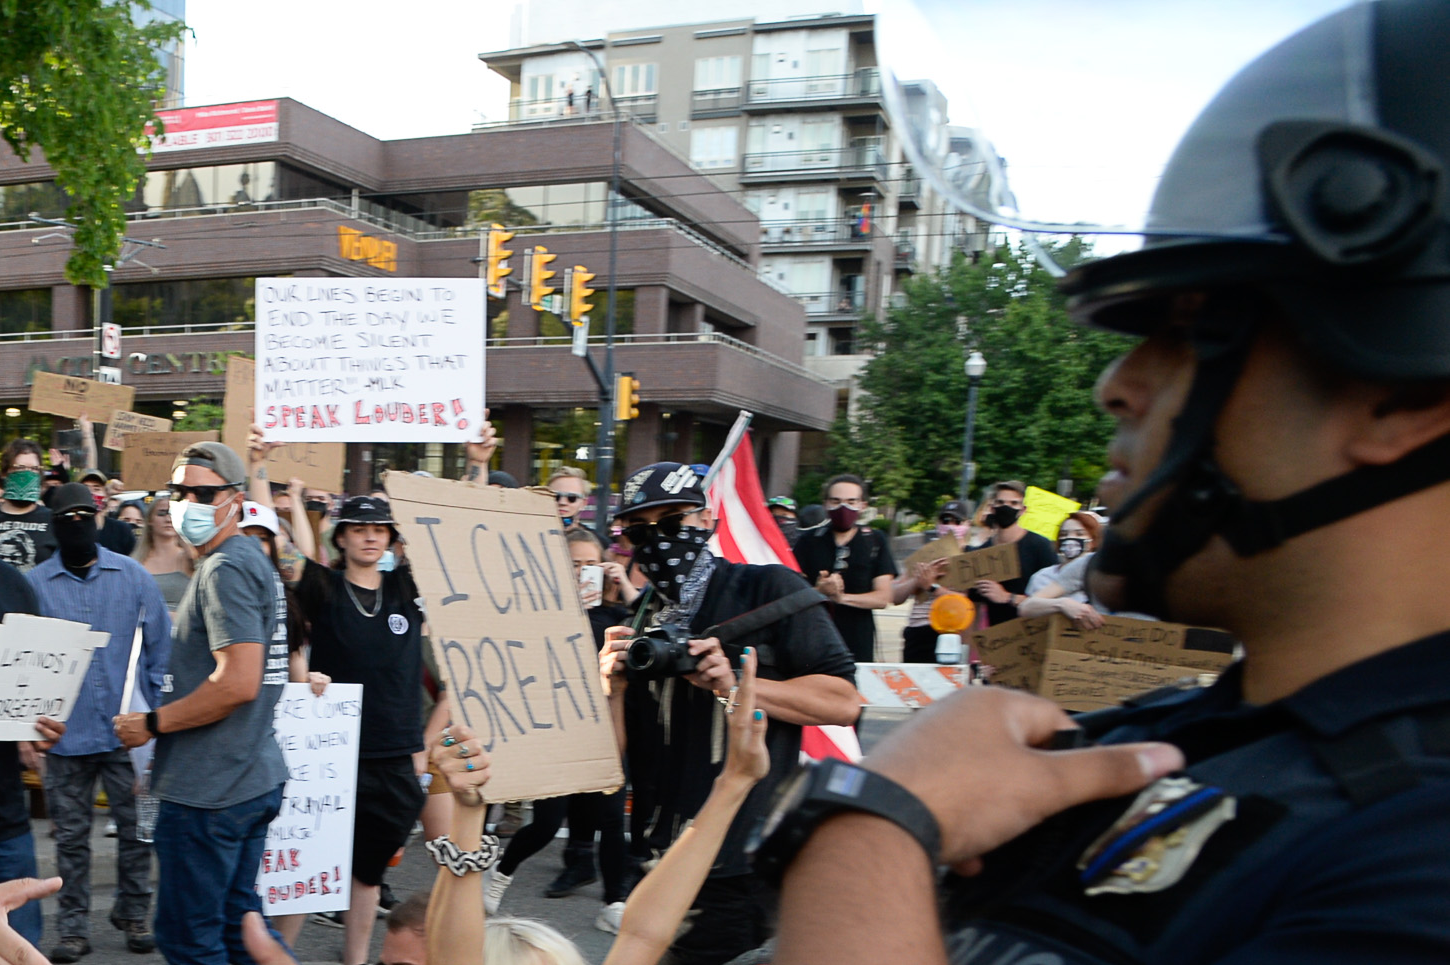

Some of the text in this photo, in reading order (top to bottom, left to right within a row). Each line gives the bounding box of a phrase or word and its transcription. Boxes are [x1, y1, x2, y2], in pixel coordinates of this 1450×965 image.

[307, 286, 358, 304] LIVES
[364, 285, 422, 303] BEGIN
[431, 286, 456, 302] TO
[267, 308, 457, 332] END THE DAY WE
[264, 332, 434, 351] BECOME SILENT
[263, 354, 469, 373] ABOUT THINGS THAT
[264, 398, 469, 431] SPEAK LOUDER!
[12, 521, 48, 532] DUDE
[415, 517, 469, 606] I
[440, 633, 600, 753] BREAT
[312, 700, 361, 718] COMES
[305, 731, 349, 751] WHEN
[318, 762, 338, 780] IS
[266, 865, 344, 904] OUDER!
